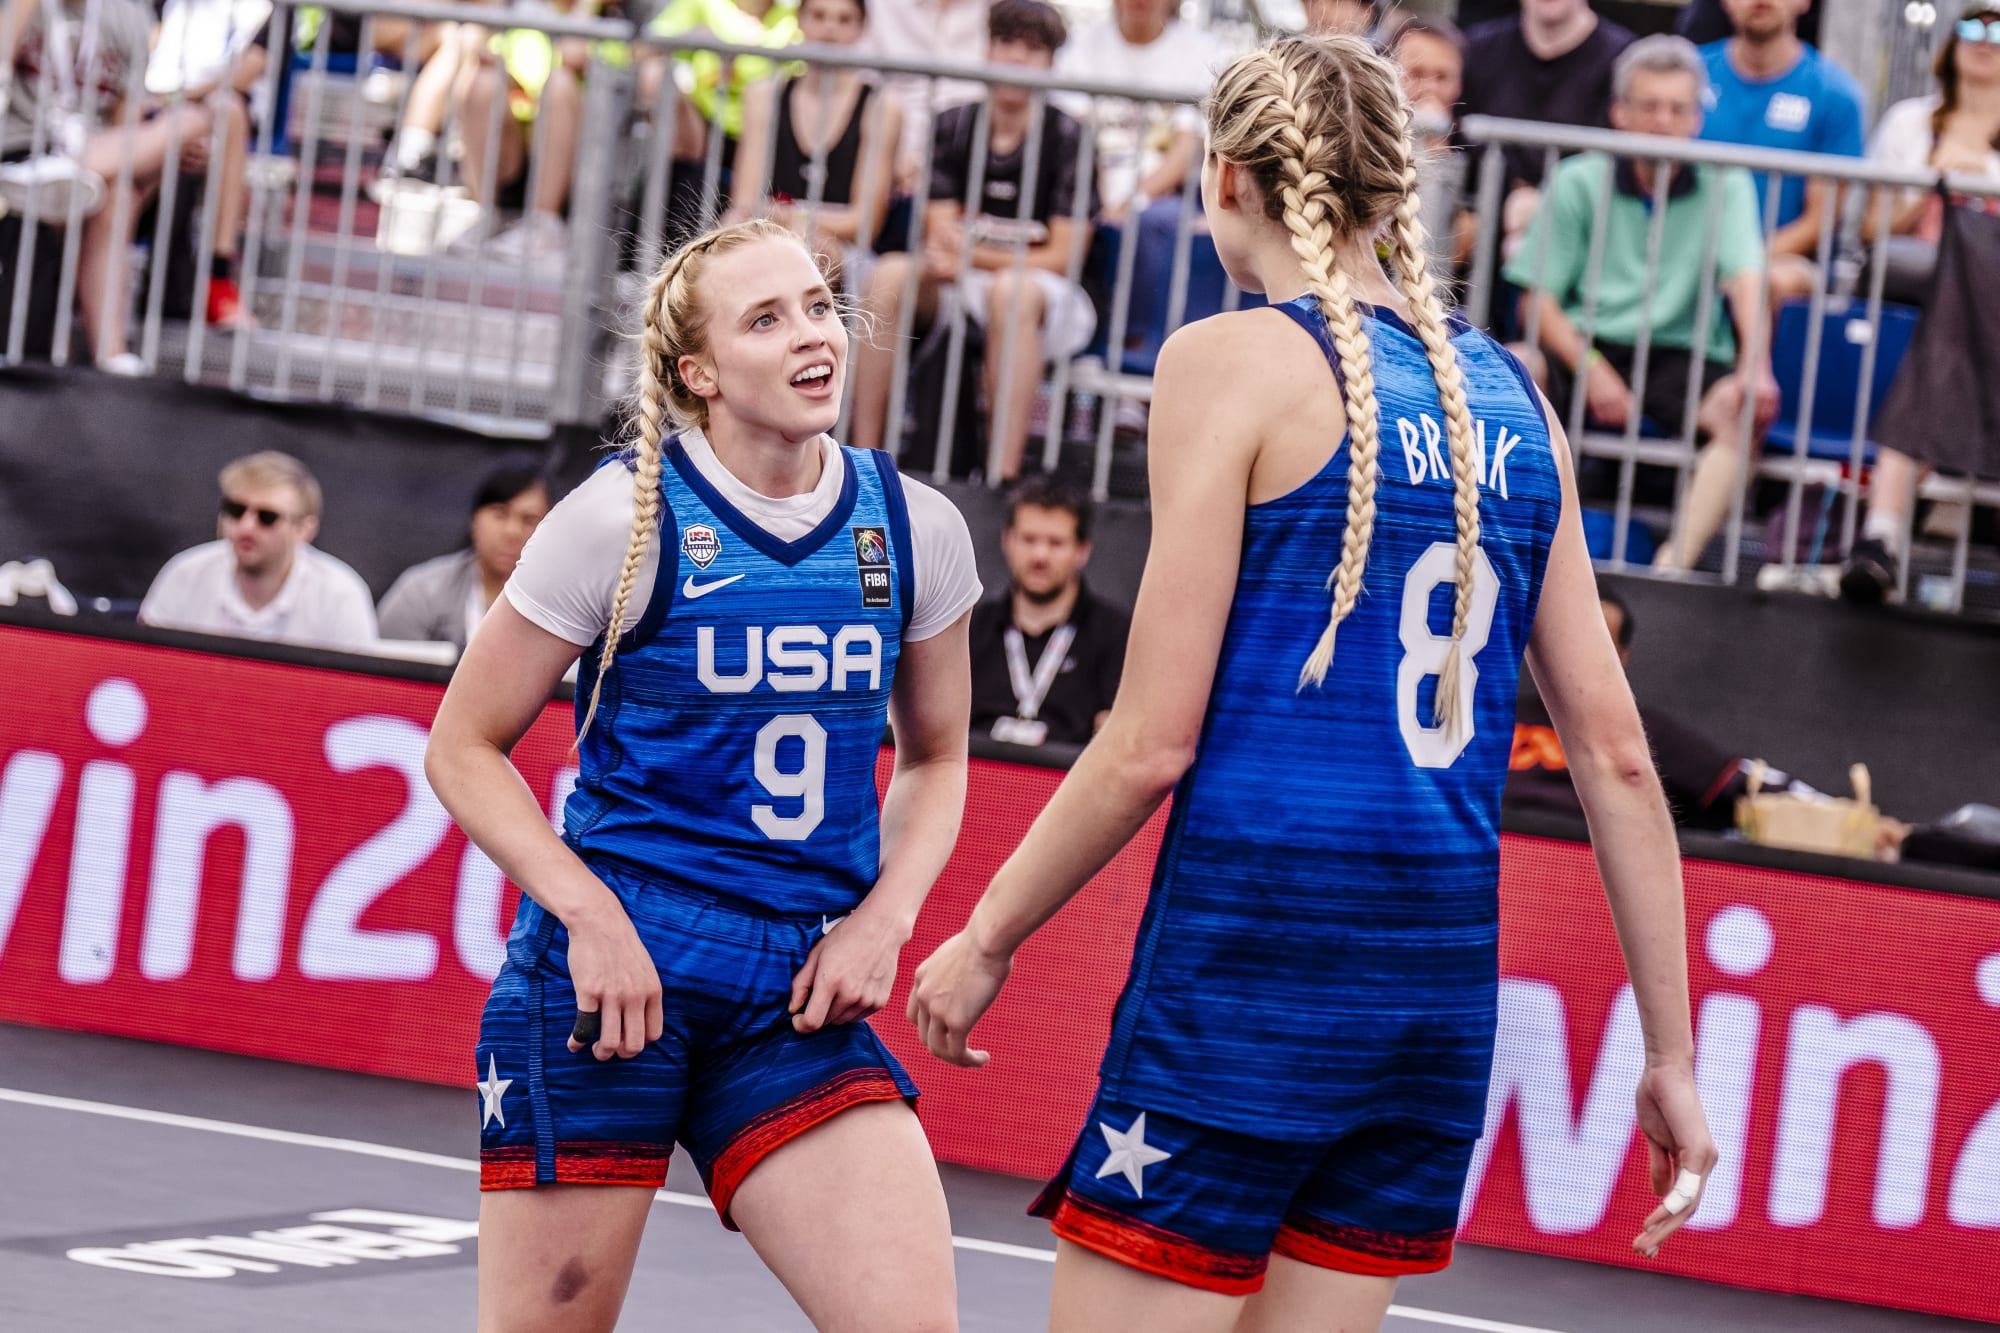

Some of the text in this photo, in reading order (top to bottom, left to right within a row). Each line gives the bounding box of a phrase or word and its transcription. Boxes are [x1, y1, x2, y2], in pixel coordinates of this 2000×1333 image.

[1396, 413, 1522, 501] BRNK
[864, 572, 888, 587] FIBA
[697, 624, 883, 693] USA
[1396, 541, 1500, 769] 8
[753, 713, 828, 841] 9
